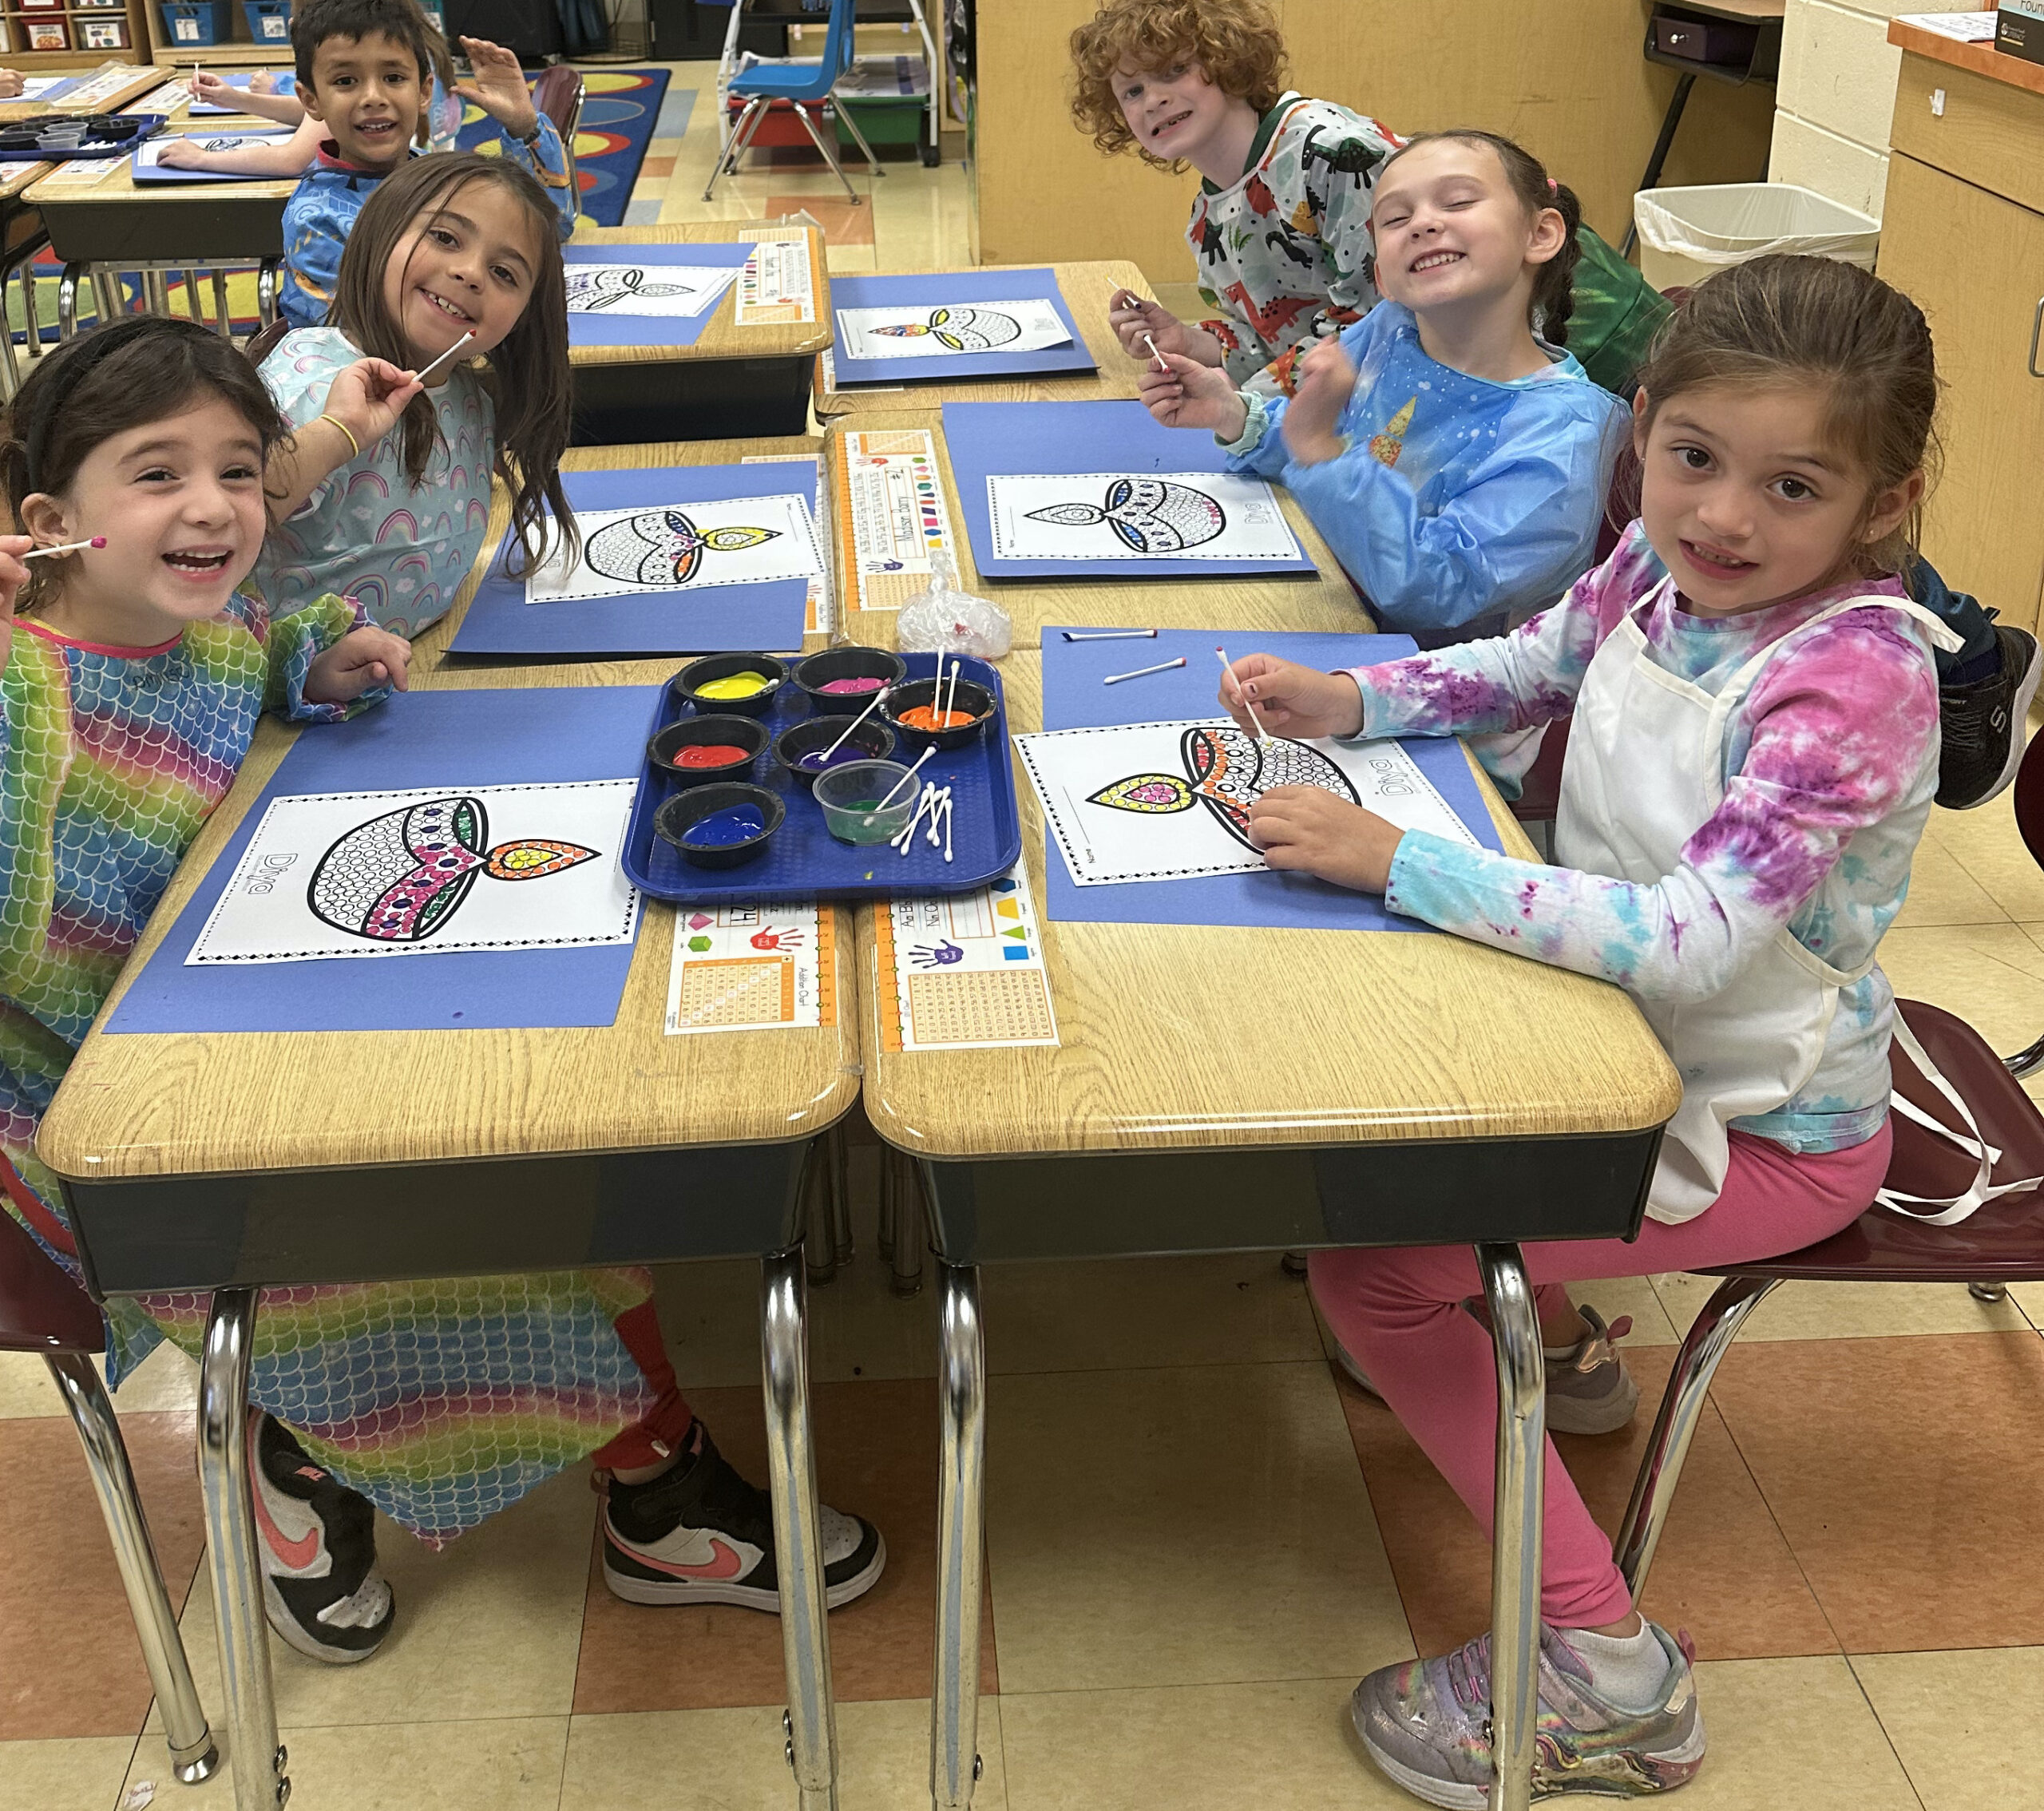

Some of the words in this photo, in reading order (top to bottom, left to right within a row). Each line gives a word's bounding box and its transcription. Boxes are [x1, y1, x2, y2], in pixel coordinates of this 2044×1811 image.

[2020, 0, 2044, 14] Foun
[1369, 759, 1414, 796] Diya
[1085, 848, 1096, 864] Name
[247, 853, 299, 895] Diya
[798, 967, 808, 989] Addition
[798, 990, 809, 1006] Chart
